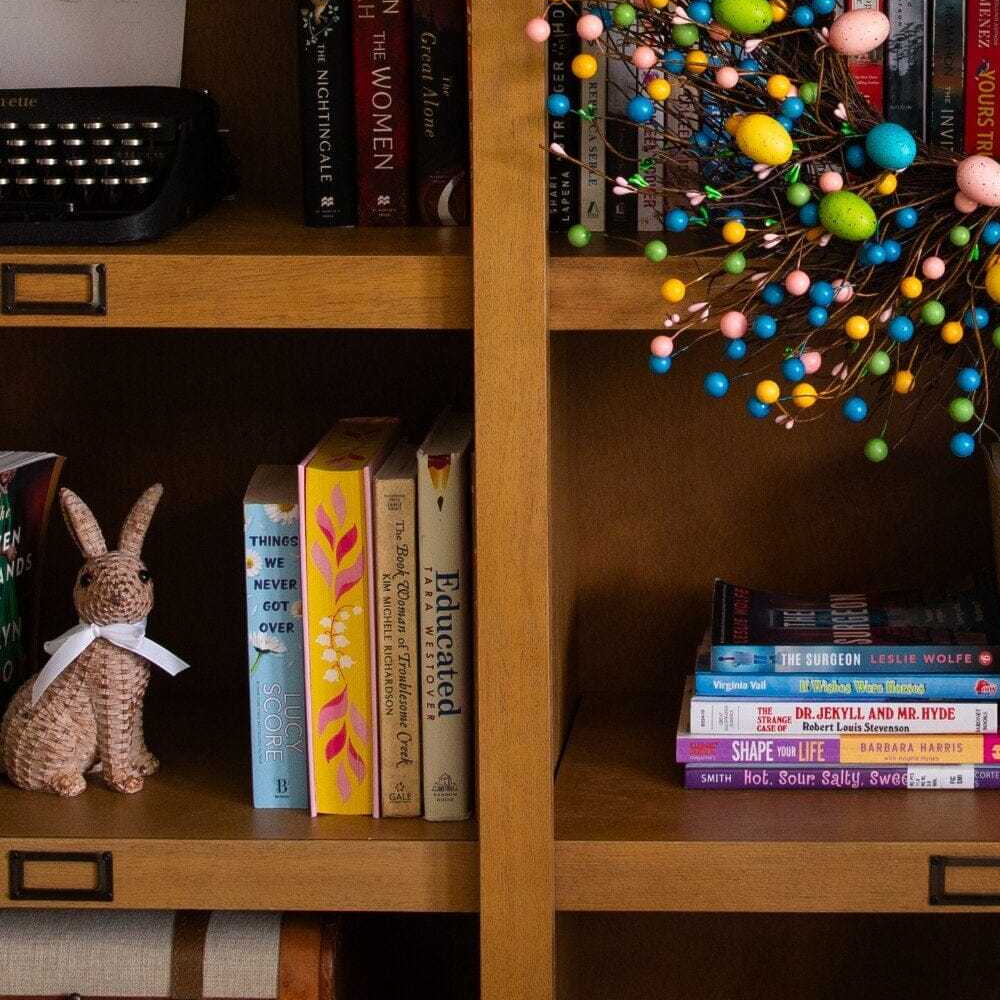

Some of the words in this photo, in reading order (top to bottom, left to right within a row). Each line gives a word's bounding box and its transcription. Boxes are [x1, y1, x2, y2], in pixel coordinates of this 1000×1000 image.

[317, 43, 326, 62] THE
[372, 30, 387, 60] THE
[317, 69, 333, 183] NIGHTINGALE
[371, 66, 395, 170] WOMEN
[561, 171, 570, 222] LAPENA
[248, 534, 299, 548] THINGS
[395, 519, 405, 542] The
[264, 557, 286, 569] WE
[392, 544, 408, 580] Book
[253, 579, 298, 591] NEVER
[381, 573, 393, 594] KIM
[424, 566, 433, 611] TARA
[262, 600, 290, 612] GOT
[395, 582, 409, 634] Woman
[259, 622, 295, 634] OVER
[382, 596, 393, 642] MICHELE
[397, 637, 409, 648] of
[433, 569, 462, 719] Educated
[781, 653, 802, 666] THE
[805, 652, 861, 667] SURGEON
[869, 654, 917, 664] LESLIE
[923, 654, 973, 664] WOLFE
[383, 645, 394, 716] RICHARDSON
[424, 626, 436, 721] WESTOVER
[397, 651, 412, 729] Troublesome
[713, 680, 748, 691] Virginia
[749, 680, 767, 690] Vail
[756, 715, 792, 725] STRANGE
[757, 706, 772, 714] THE
[795, 706, 814, 720] DR.
[815, 706, 864, 722] JEKYLL
[868, 706, 894, 720] AND
[897, 707, 920, 720] MR.
[921, 707, 956, 720] HYDE
[264, 682, 284, 763] SCORE
[756, 724, 775, 733] CASE
[776, 724, 788, 733] OF
[801, 722, 834, 732] Robert
[836, 722, 855, 732] Louis
[863, 722, 910, 733] Stevenson
[395, 731, 413, 768] Creek
[731, 740, 774, 762] SHAPE
[777, 746, 797, 757] YOUR
[798, 741, 825, 761] LIFE
[860, 742, 914, 753] BARBARA
[919, 742, 964, 753] HARRIS
